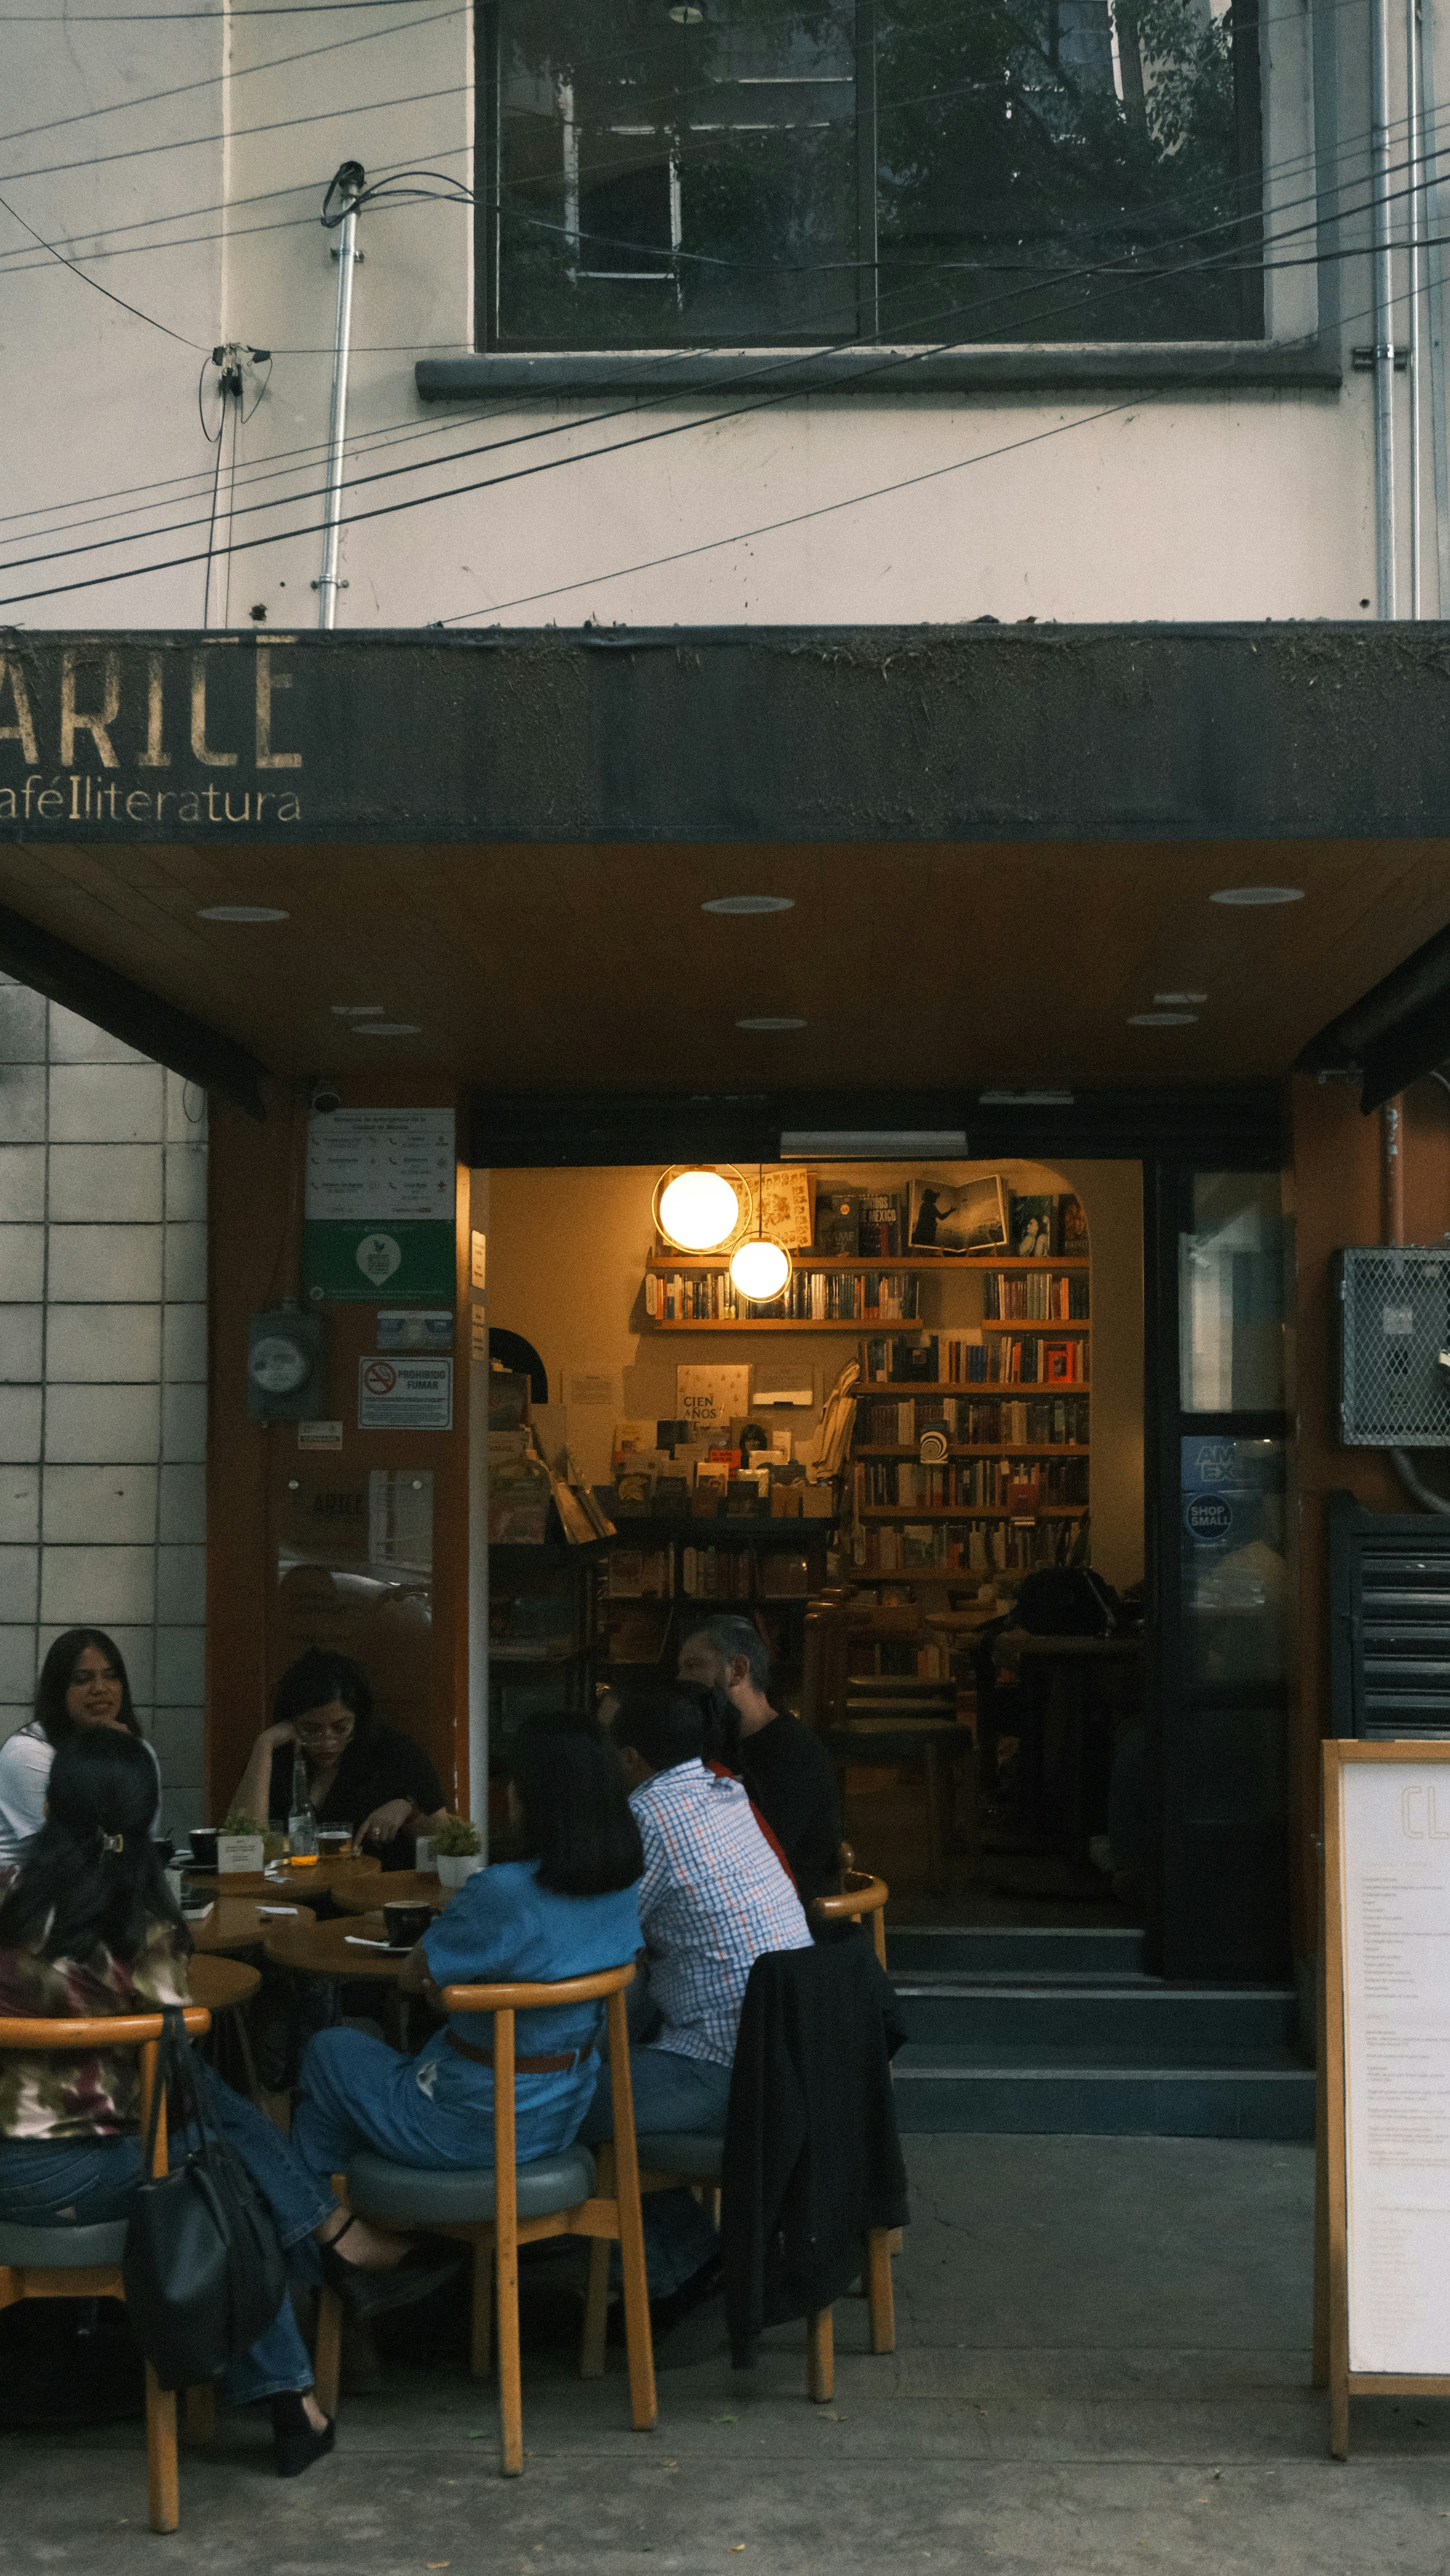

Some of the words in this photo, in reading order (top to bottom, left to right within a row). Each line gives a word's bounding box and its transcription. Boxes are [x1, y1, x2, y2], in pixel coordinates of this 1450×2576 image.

[398, 1370, 446, 1380] PROHIBIDO
[407, 1380, 438, 1390] FUMAR
[684, 1397, 713, 1407] CIEN
[683, 1407, 717, 1419] AÑOS
[1191, 1506, 1225, 1516] SHOP
[1191, 1516, 1231, 1526] SMALL
